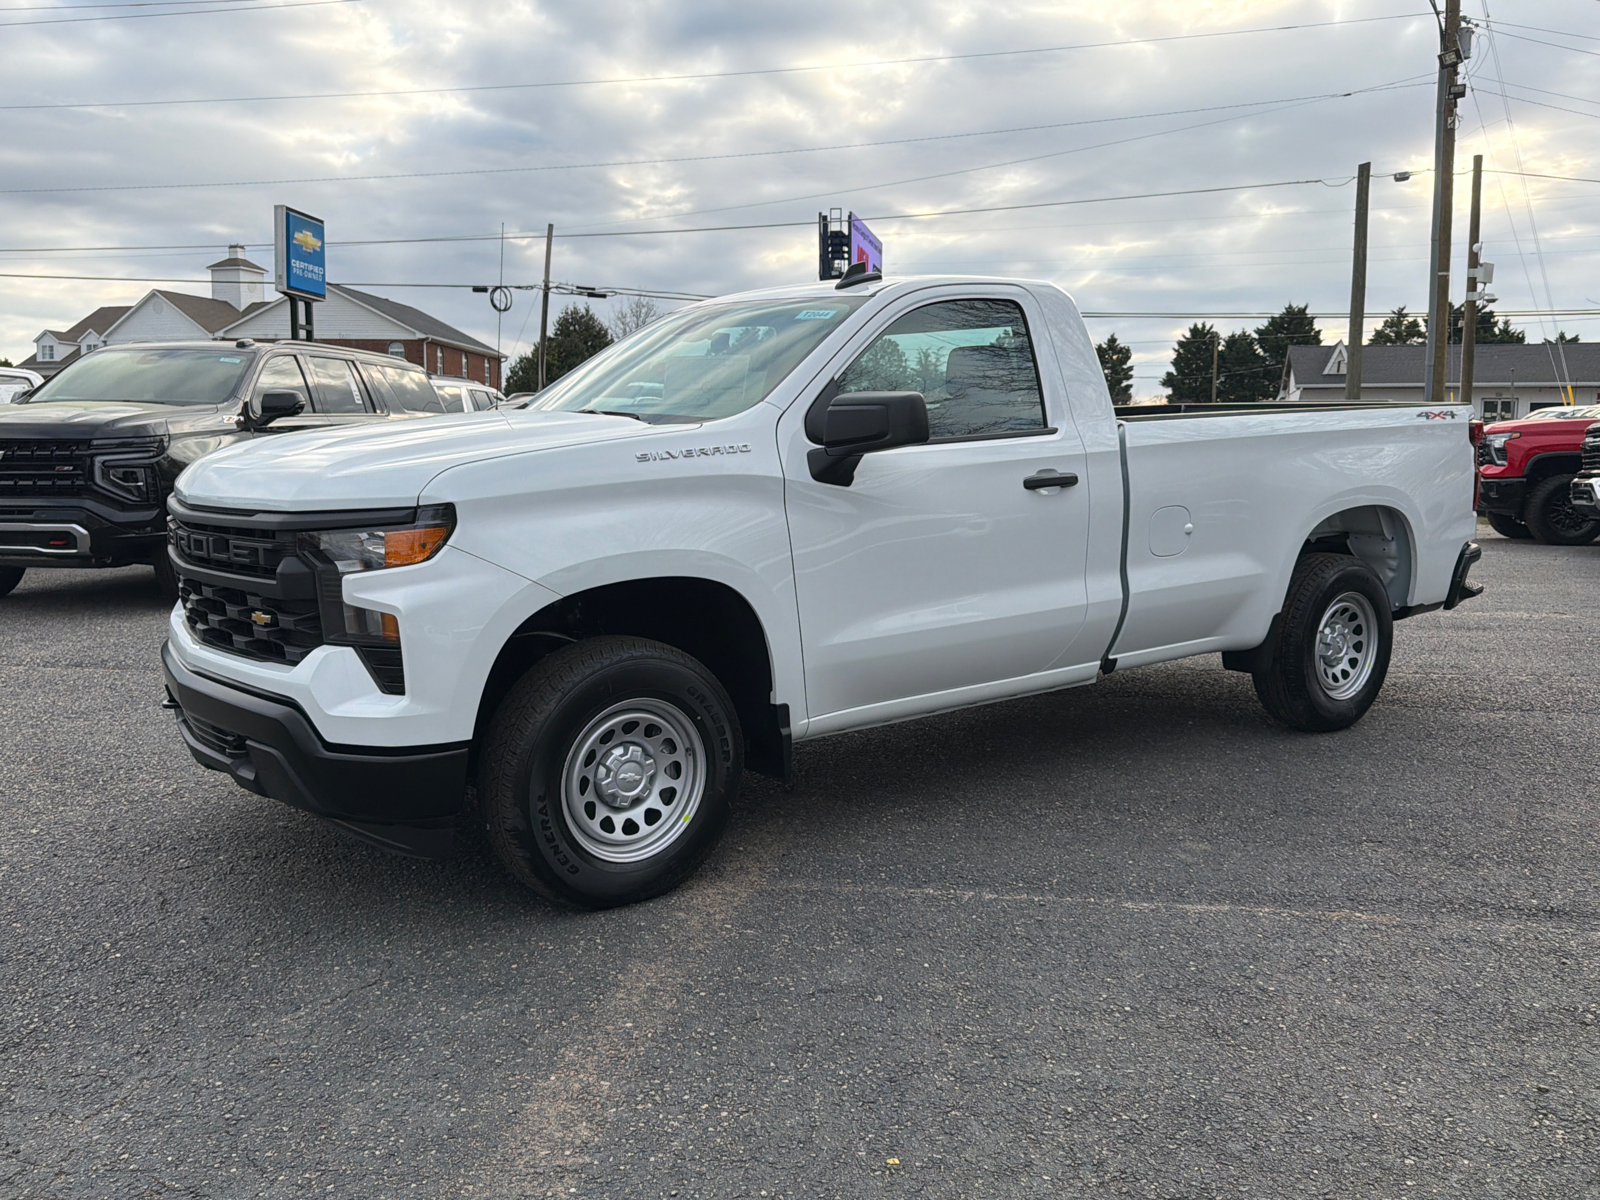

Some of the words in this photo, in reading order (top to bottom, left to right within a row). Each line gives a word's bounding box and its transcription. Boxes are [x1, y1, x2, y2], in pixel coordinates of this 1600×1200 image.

[291, 259, 324, 275] CERTIFIED
[293, 267, 323, 282] PRE-OWNED
[635, 443, 752, 463] SILVERADO
[537, 792, 580, 875] GENERAL
